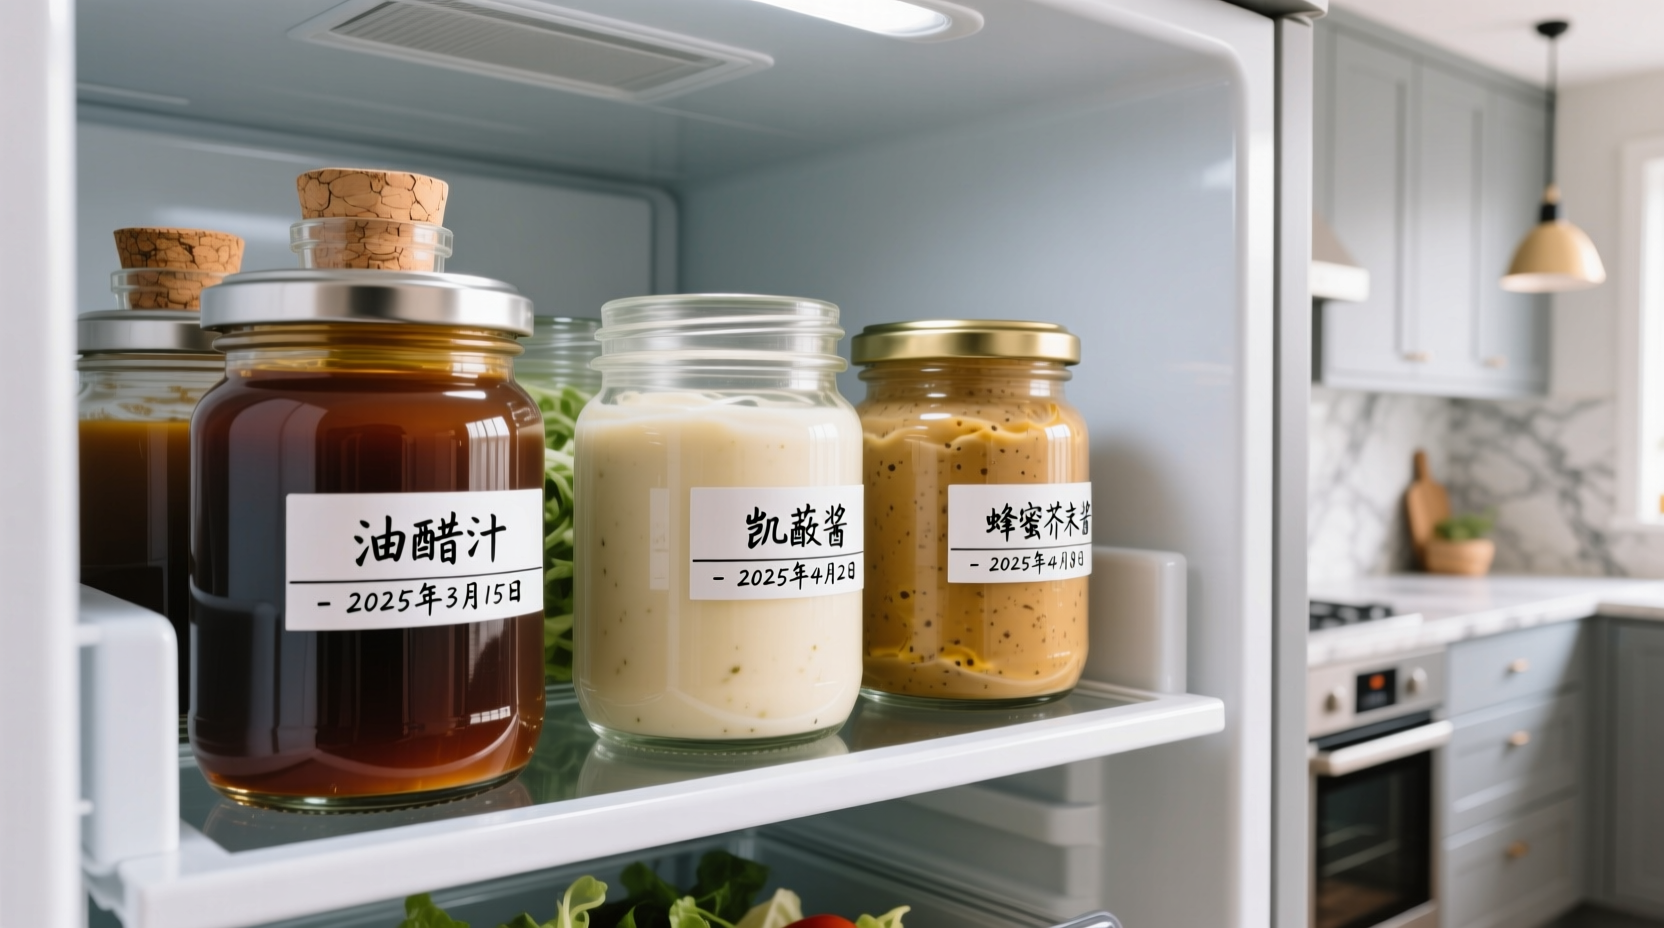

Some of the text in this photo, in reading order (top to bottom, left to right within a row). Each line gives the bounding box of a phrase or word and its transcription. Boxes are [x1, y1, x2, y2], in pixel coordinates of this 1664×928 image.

[353, 510, 507, 568] 油醋汁
[736, 561, 856, 591] 2025年4月2日
[345, 579, 522, 617] 2025年3月15日
